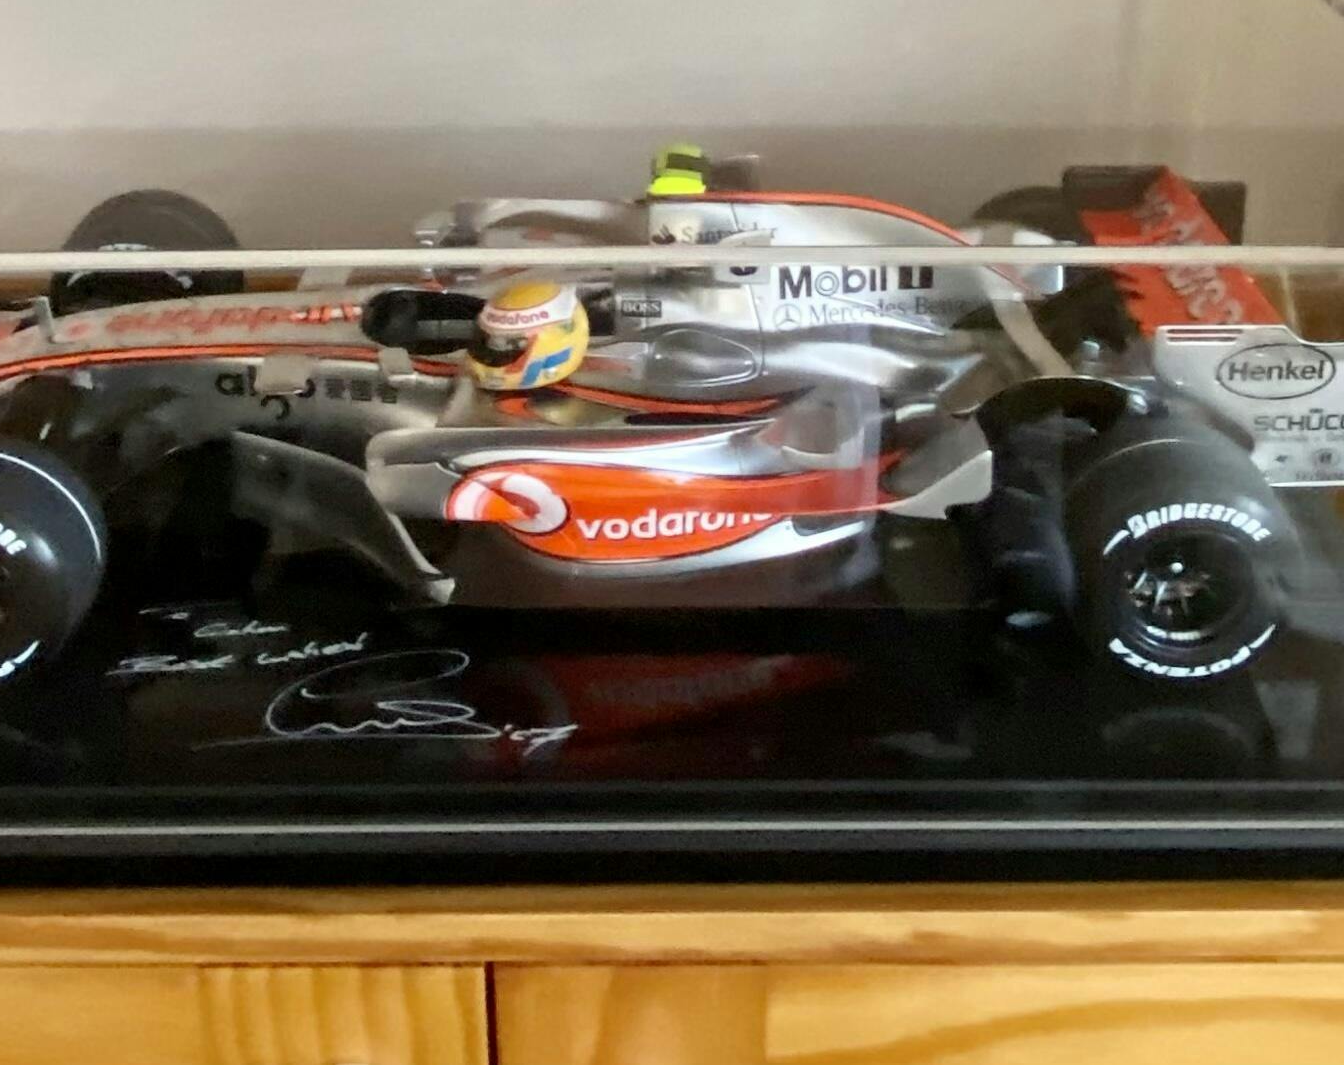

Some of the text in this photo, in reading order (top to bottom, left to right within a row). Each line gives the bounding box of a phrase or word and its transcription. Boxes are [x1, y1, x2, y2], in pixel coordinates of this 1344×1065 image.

[779, 265, 888, 300] Mobil
[1228, 359, 1325, 382] Henkel
[1127, 502, 1273, 542] BRIDGESTONE
